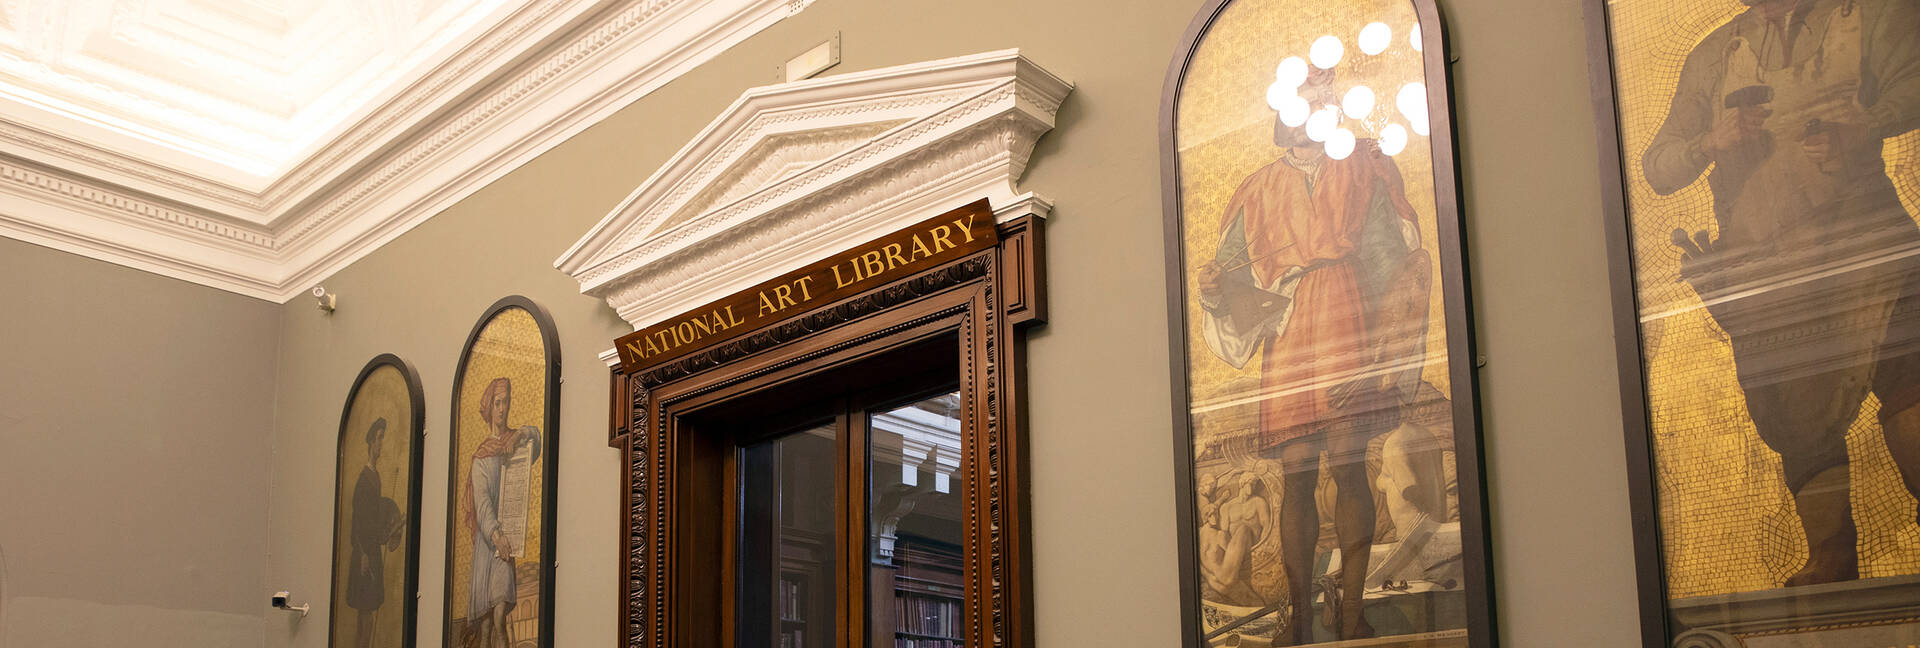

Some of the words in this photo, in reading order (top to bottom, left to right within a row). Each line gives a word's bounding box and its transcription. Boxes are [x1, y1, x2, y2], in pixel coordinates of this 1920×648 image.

[626, 305, 744, 363] NATIONAL
[757, 276, 814, 318] ART
[831, 214, 976, 289] LIBRARY
